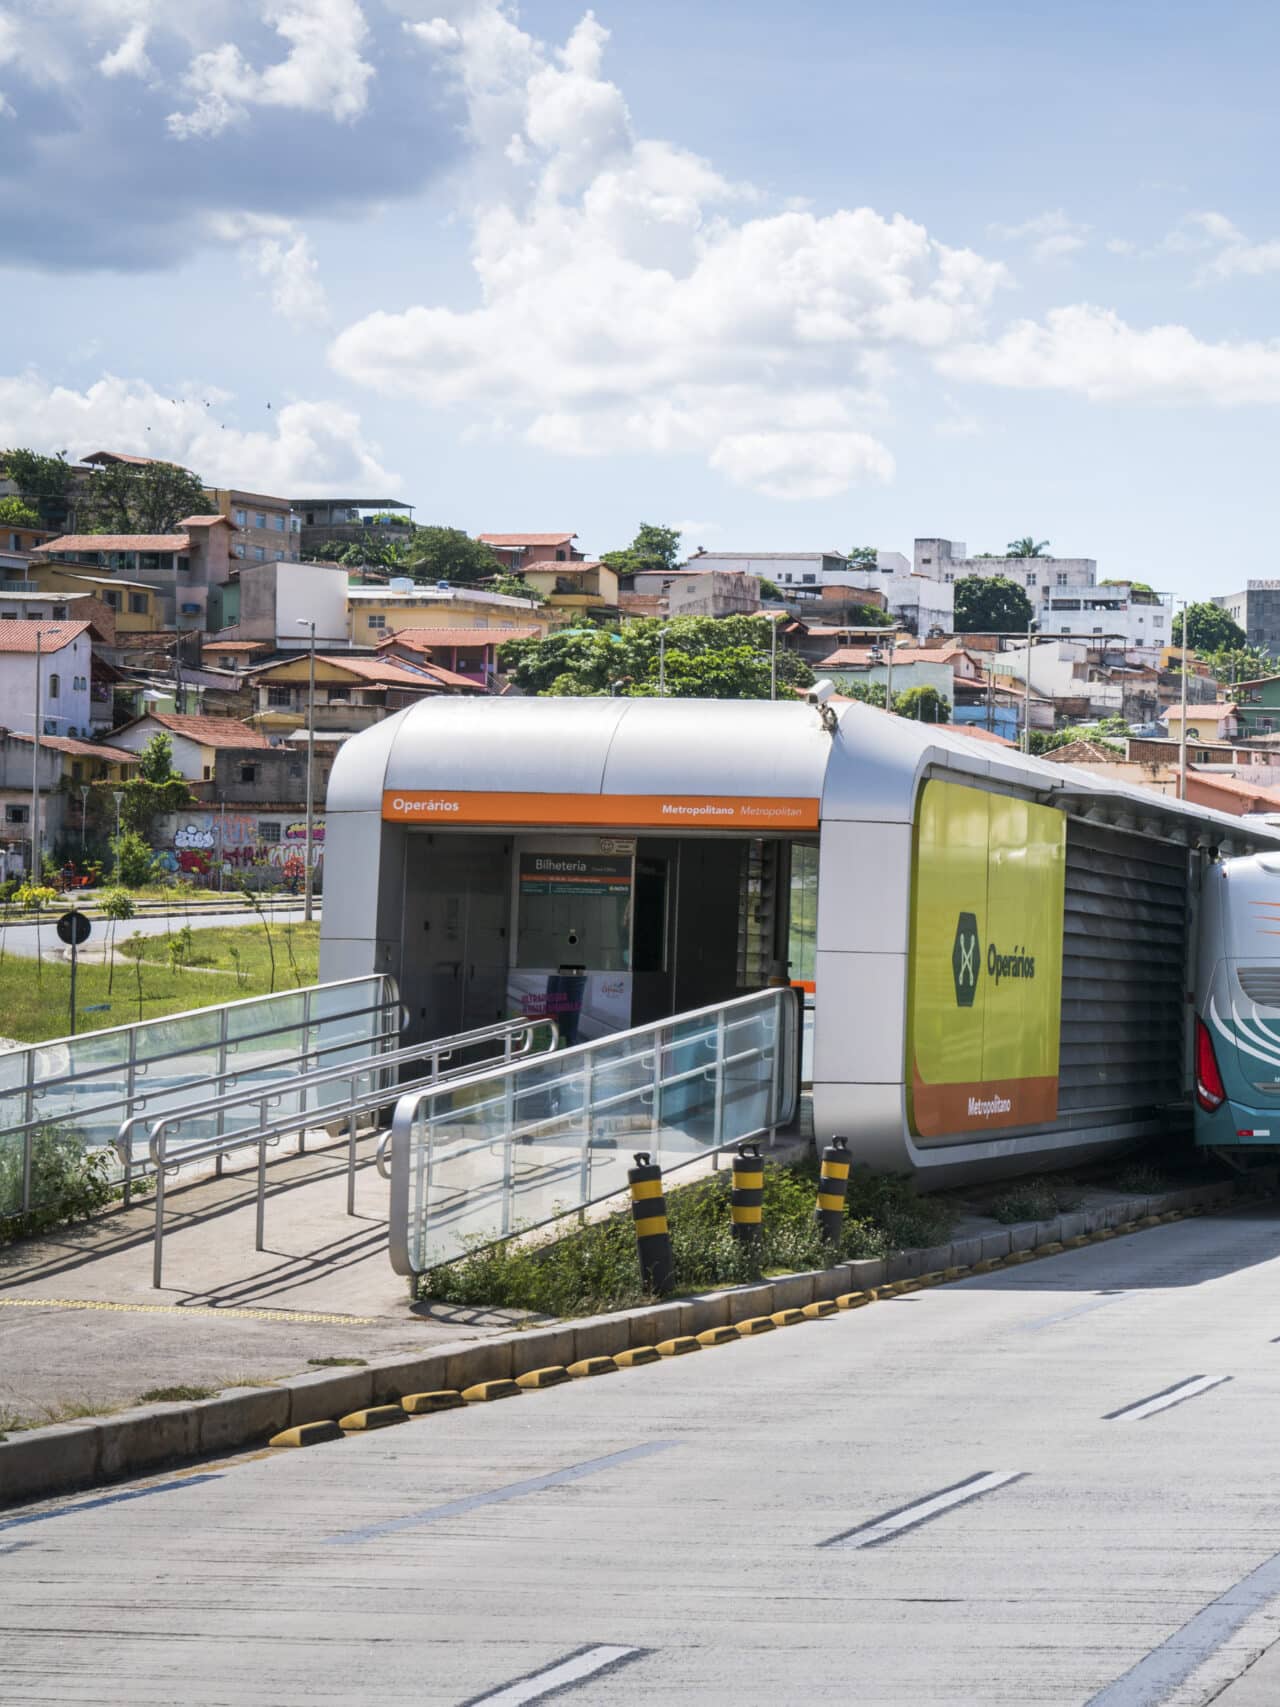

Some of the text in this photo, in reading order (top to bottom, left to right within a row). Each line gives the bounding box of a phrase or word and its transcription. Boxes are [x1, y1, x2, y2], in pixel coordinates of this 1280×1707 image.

[393, 798, 459, 814] Operários
[662, 804, 802, 818] Metropolitano Metropolitan
[535, 858, 587, 872] Bilheteria
[987, 943, 1035, 986] Operários
[968, 1093, 1011, 1120] Metropolitano
